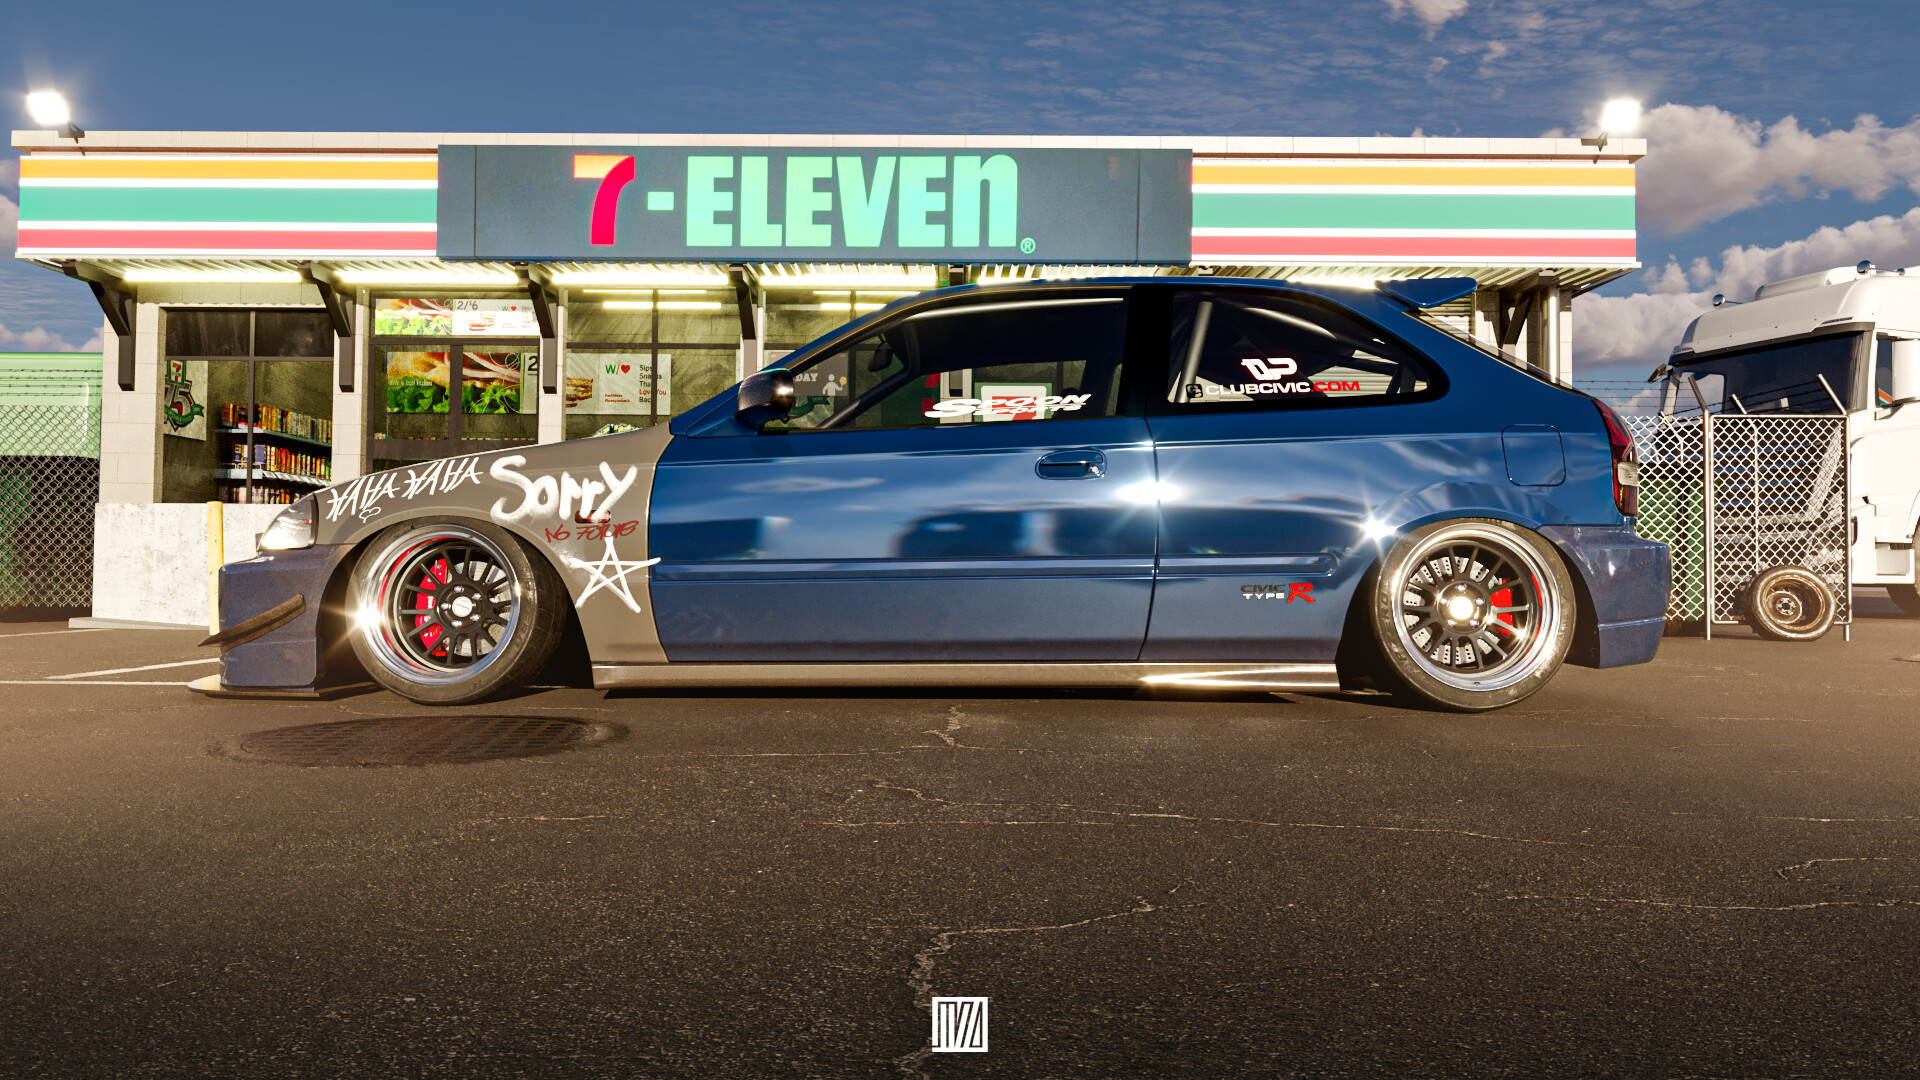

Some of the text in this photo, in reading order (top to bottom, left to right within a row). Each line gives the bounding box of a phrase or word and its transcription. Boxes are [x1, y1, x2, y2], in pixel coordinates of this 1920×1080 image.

[1205, 381, 1361, 395] CLUBCIVIC.COM
[1241, 585, 1286, 593] CIVIC
[1286, 582, 1316, 604] R
